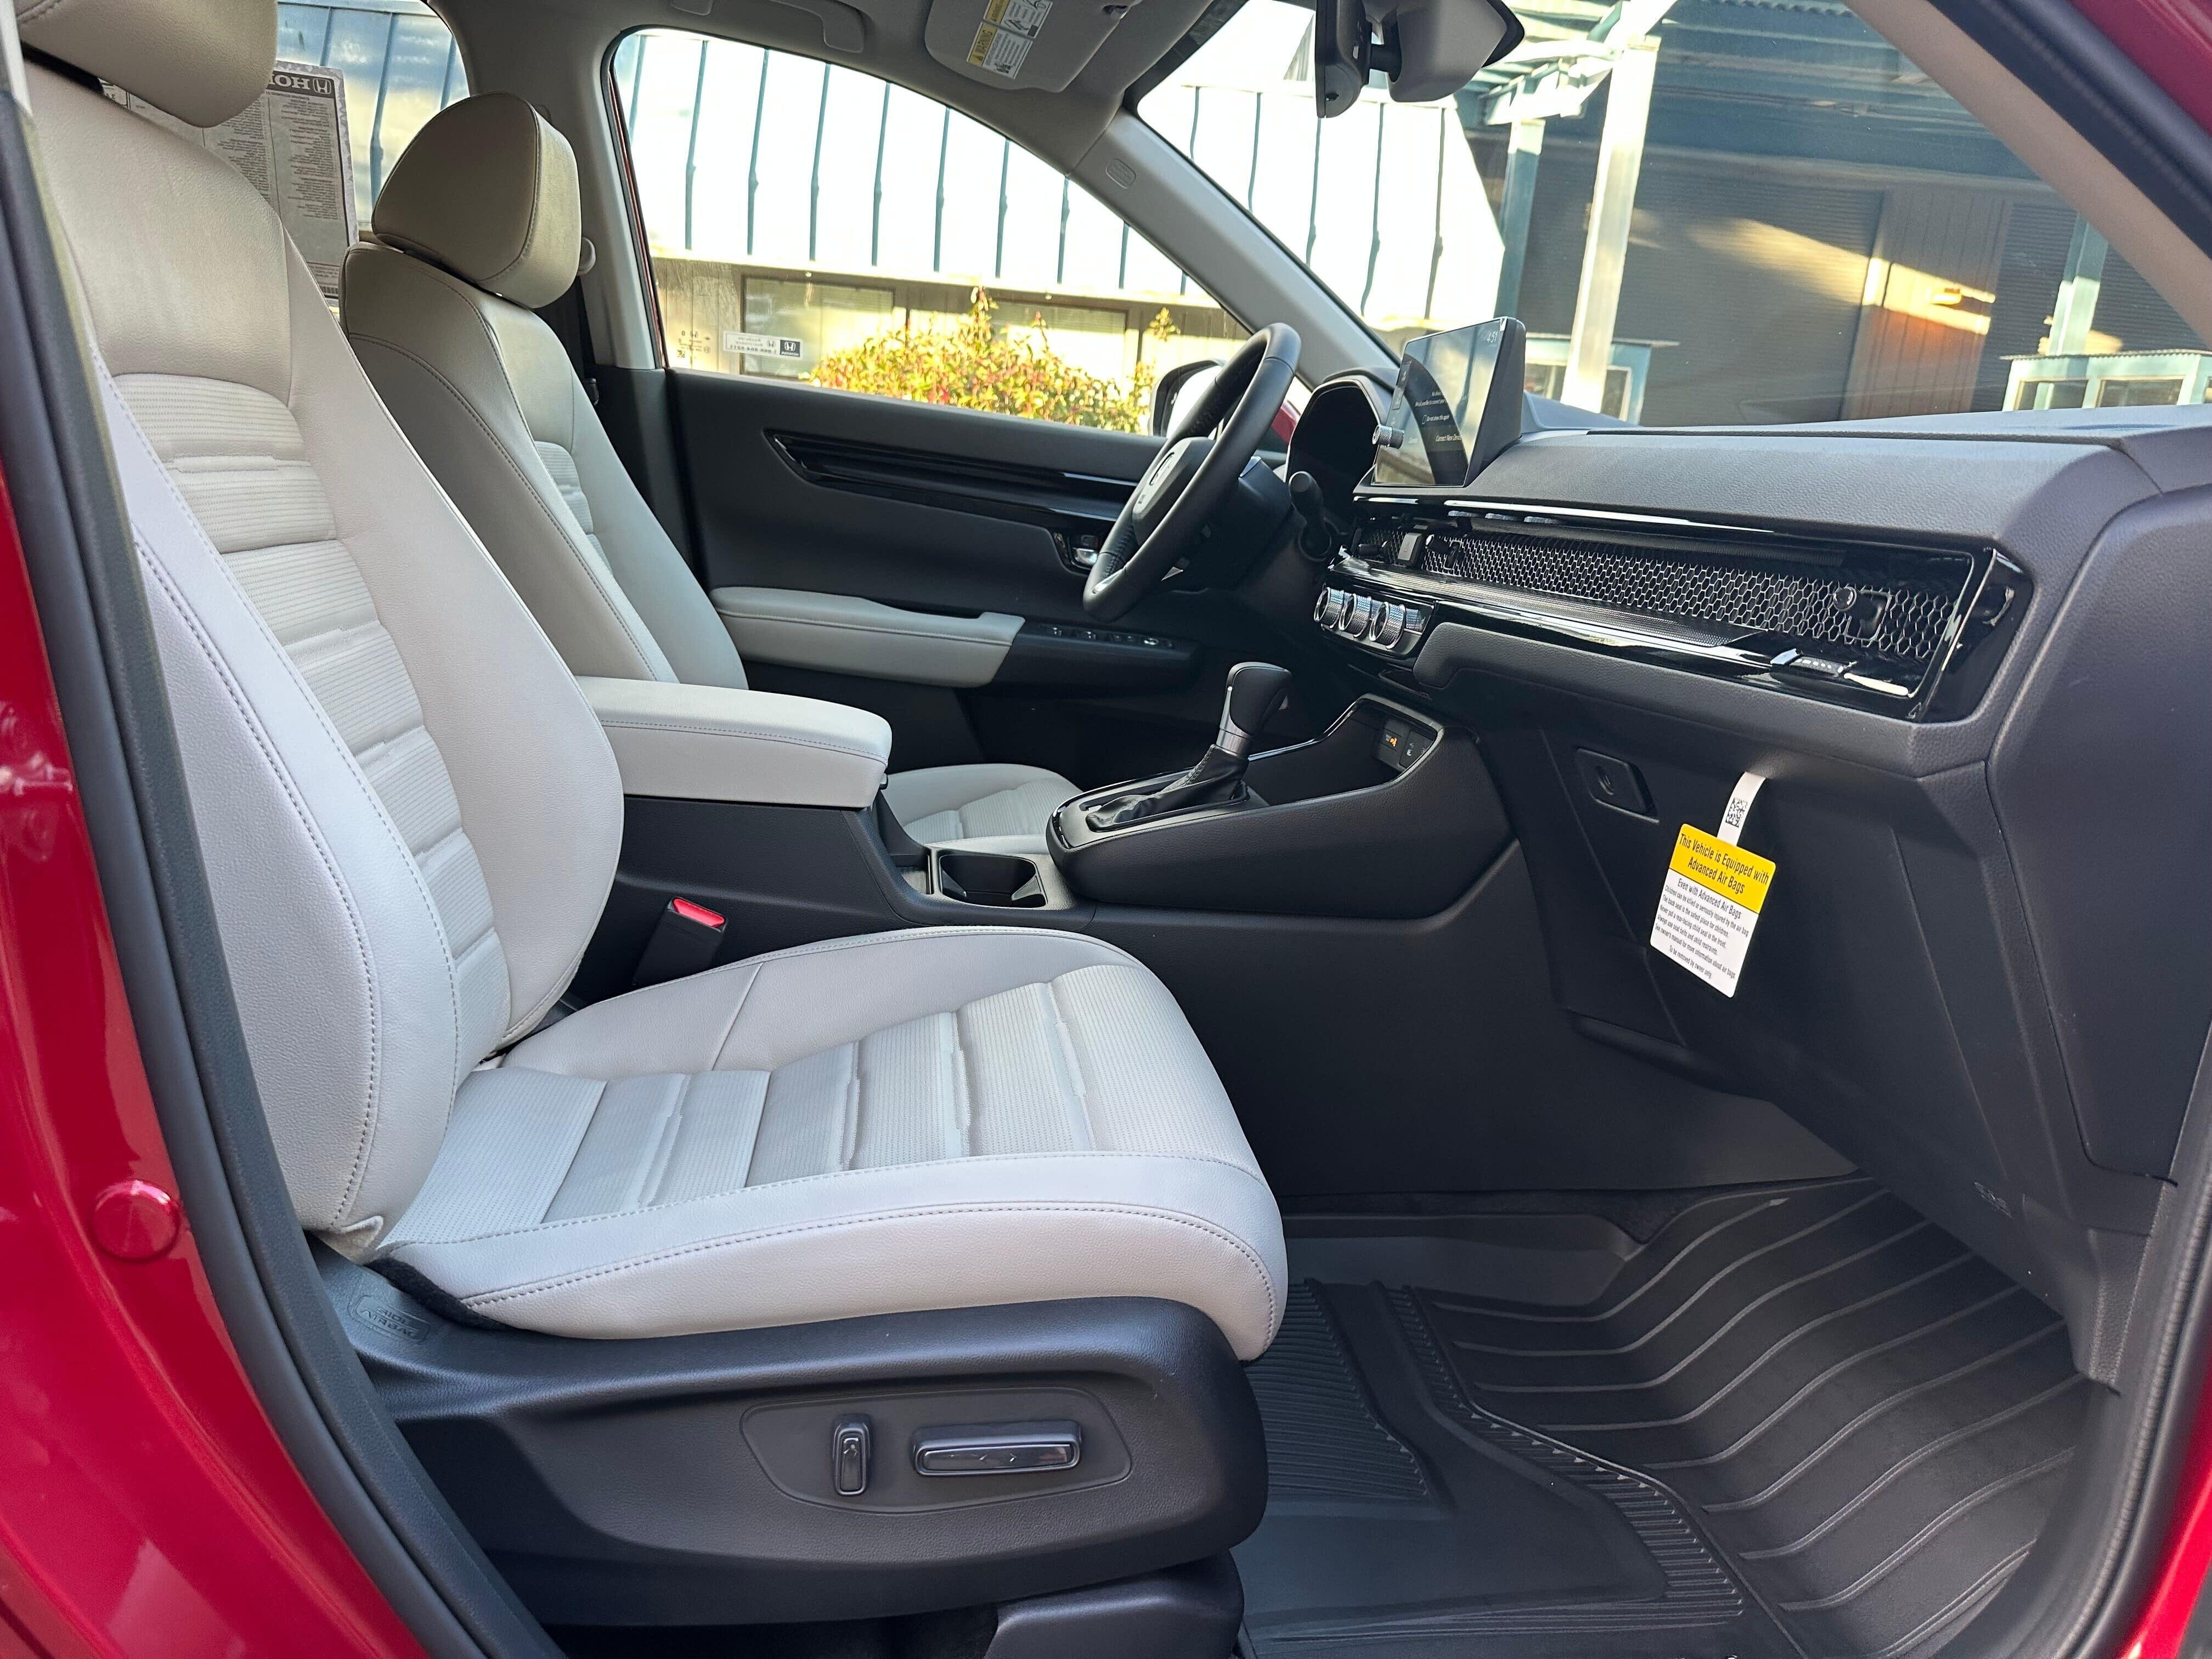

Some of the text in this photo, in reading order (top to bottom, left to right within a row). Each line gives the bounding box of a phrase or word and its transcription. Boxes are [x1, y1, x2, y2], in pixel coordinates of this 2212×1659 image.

[1679, 833, 1769, 884] This Vehicle is Equipped with
[1688, 857, 1745, 894] Advanced Air Bags
[1678, 878, 1741, 919] Even with Advanced Air Bags
[362, 1310, 419, 1338] AIRBAG
[377, 1307, 410, 1325] SIDE
